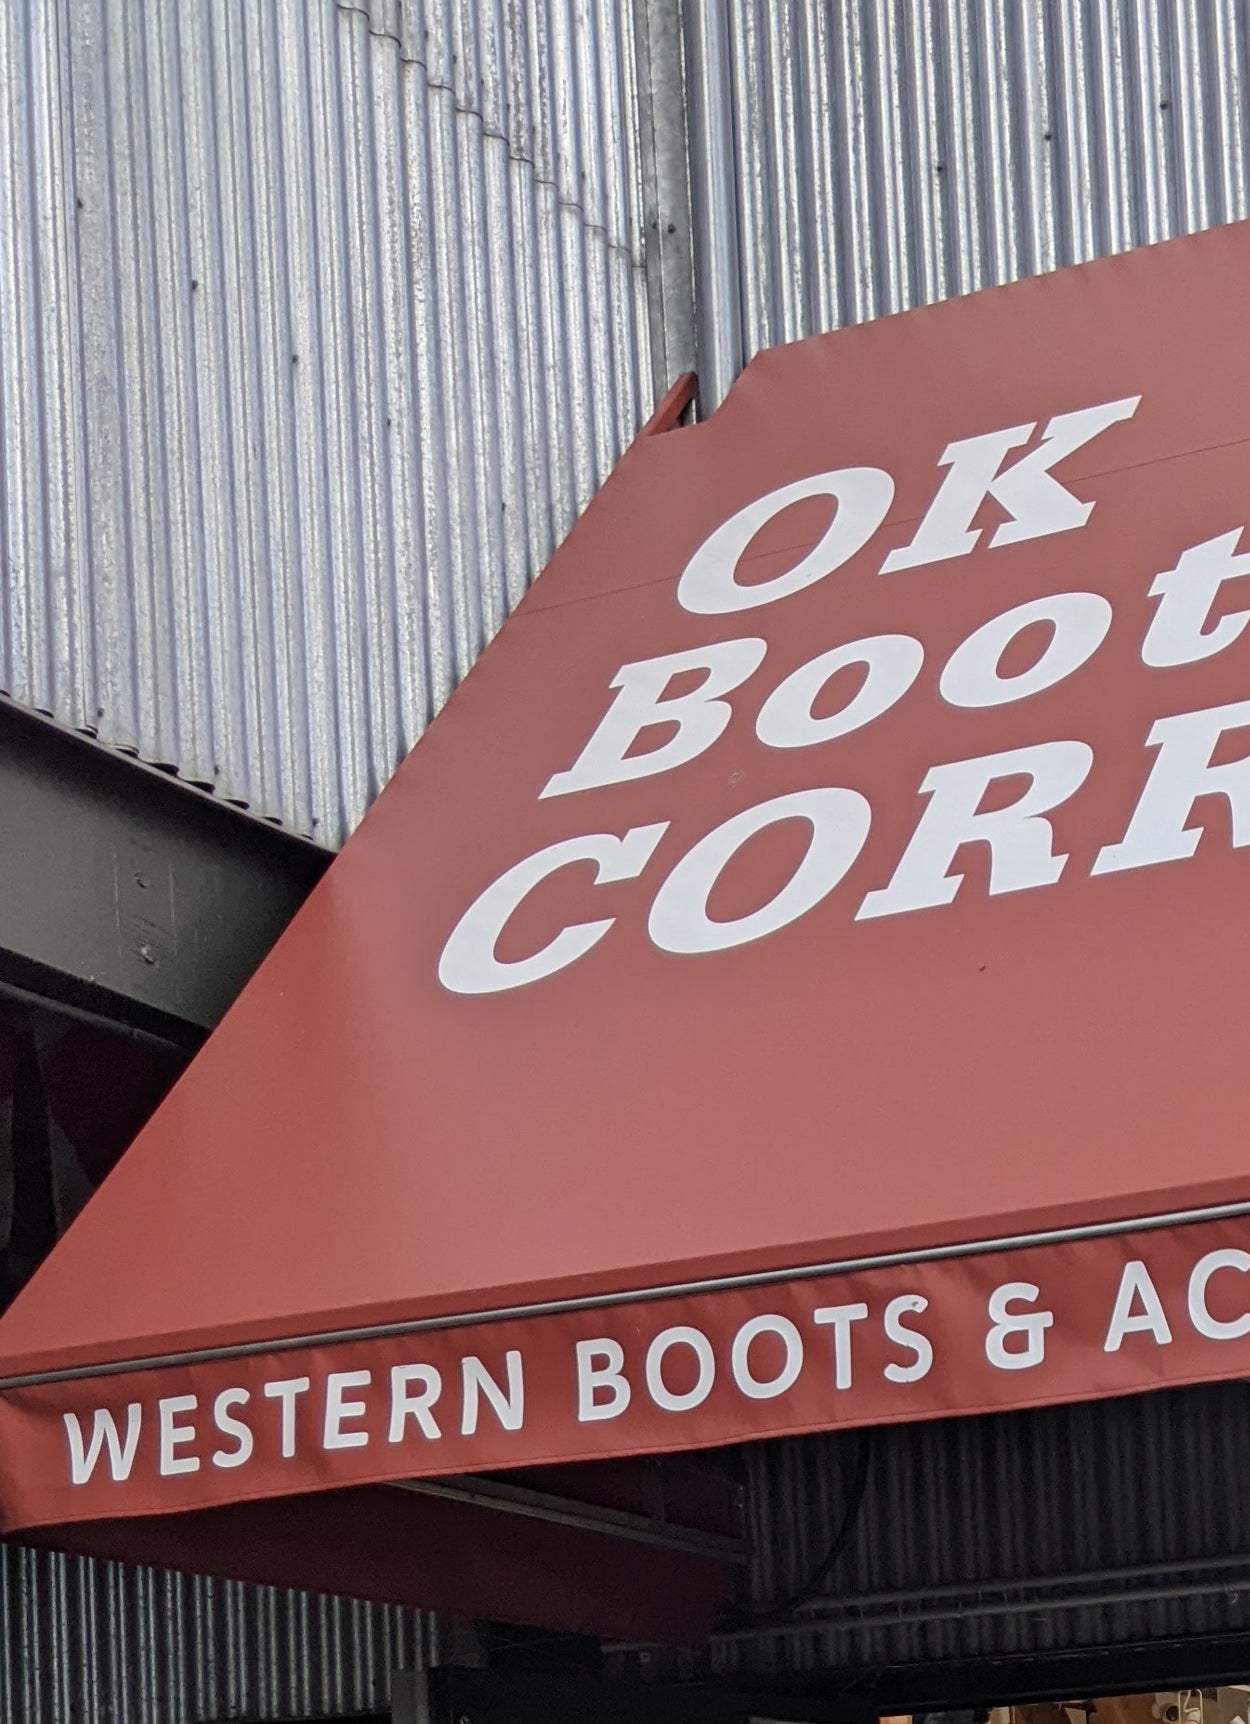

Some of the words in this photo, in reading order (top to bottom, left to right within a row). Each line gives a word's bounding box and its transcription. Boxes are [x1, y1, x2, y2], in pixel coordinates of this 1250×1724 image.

[676, 394, 1143, 615] OK
[63, 1349, 525, 1485] WESTERN
[576, 1292, 934, 1424] BOOTS
[984, 1281, 1054, 1370] &
